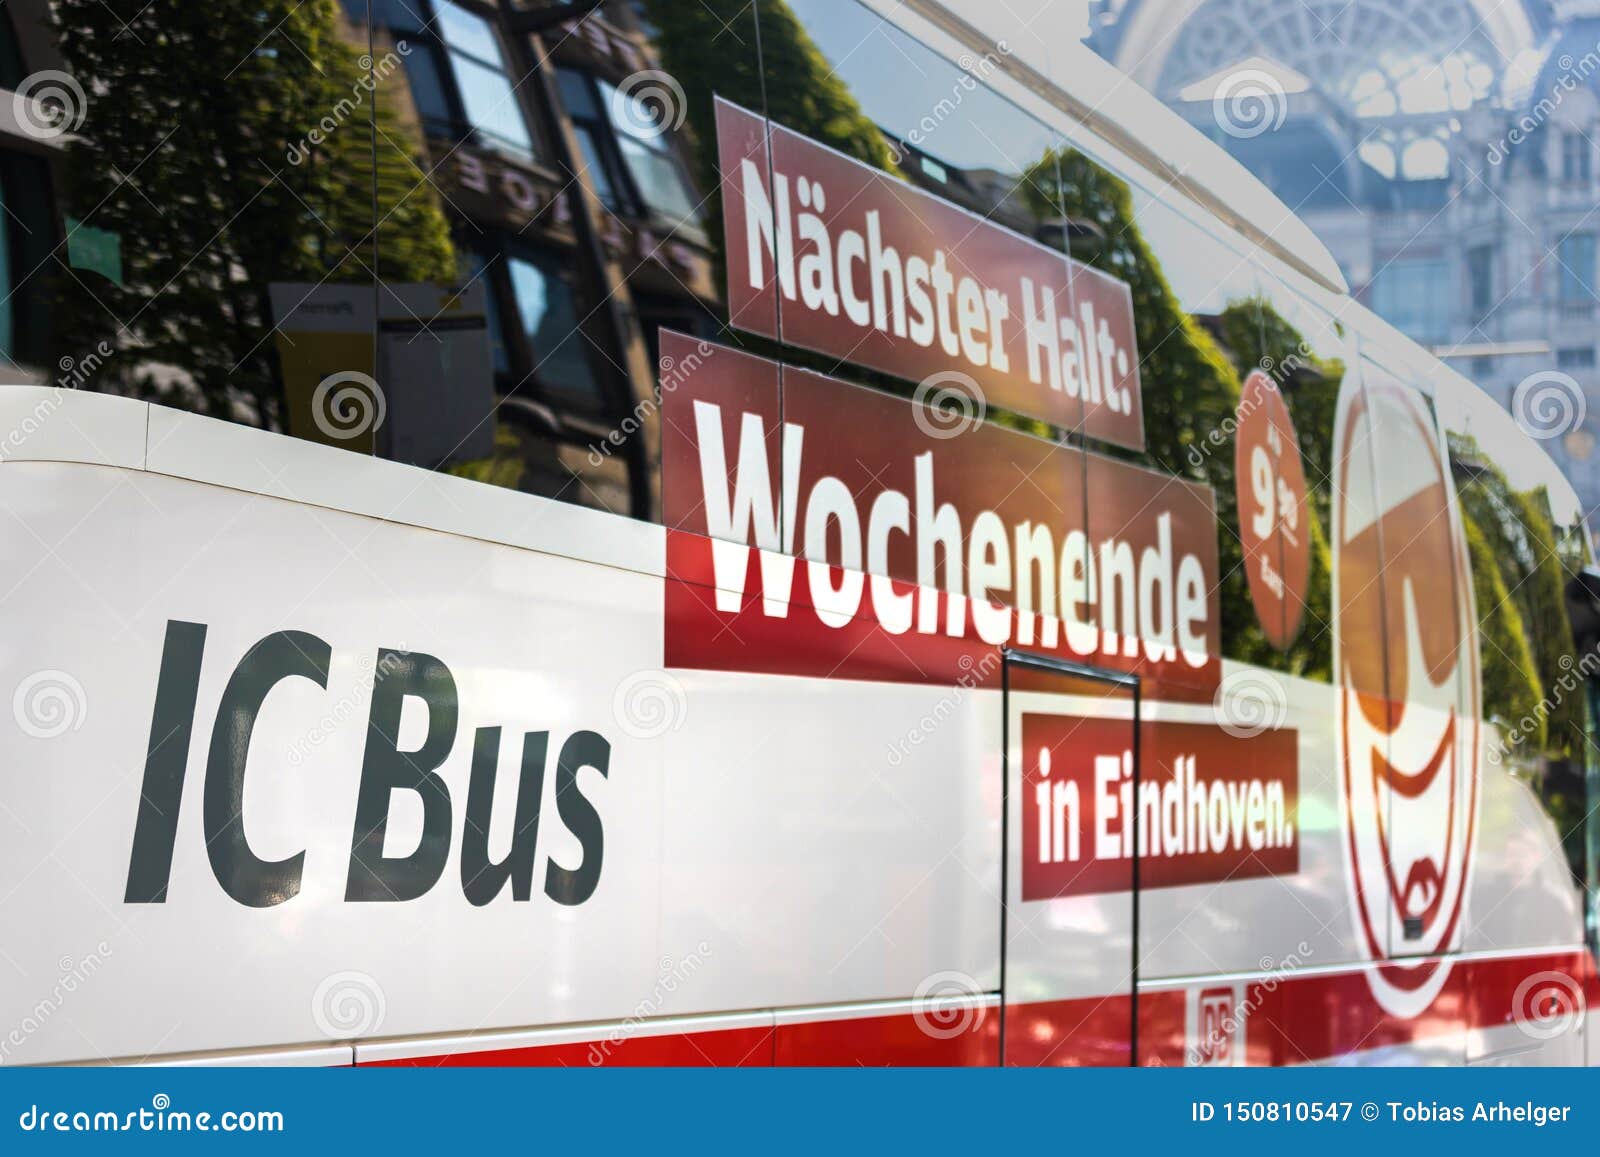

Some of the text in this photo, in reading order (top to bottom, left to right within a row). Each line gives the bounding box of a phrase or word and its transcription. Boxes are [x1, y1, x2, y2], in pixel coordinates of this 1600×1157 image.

[741, 158, 1009, 374] Nächster
[1020, 276, 1132, 417] Halt:
[693, 399, 1210, 668] Wochenende
[123, 619, 612, 908] IC Bus
[1036, 746, 1294, 864] in Eindhoven.
